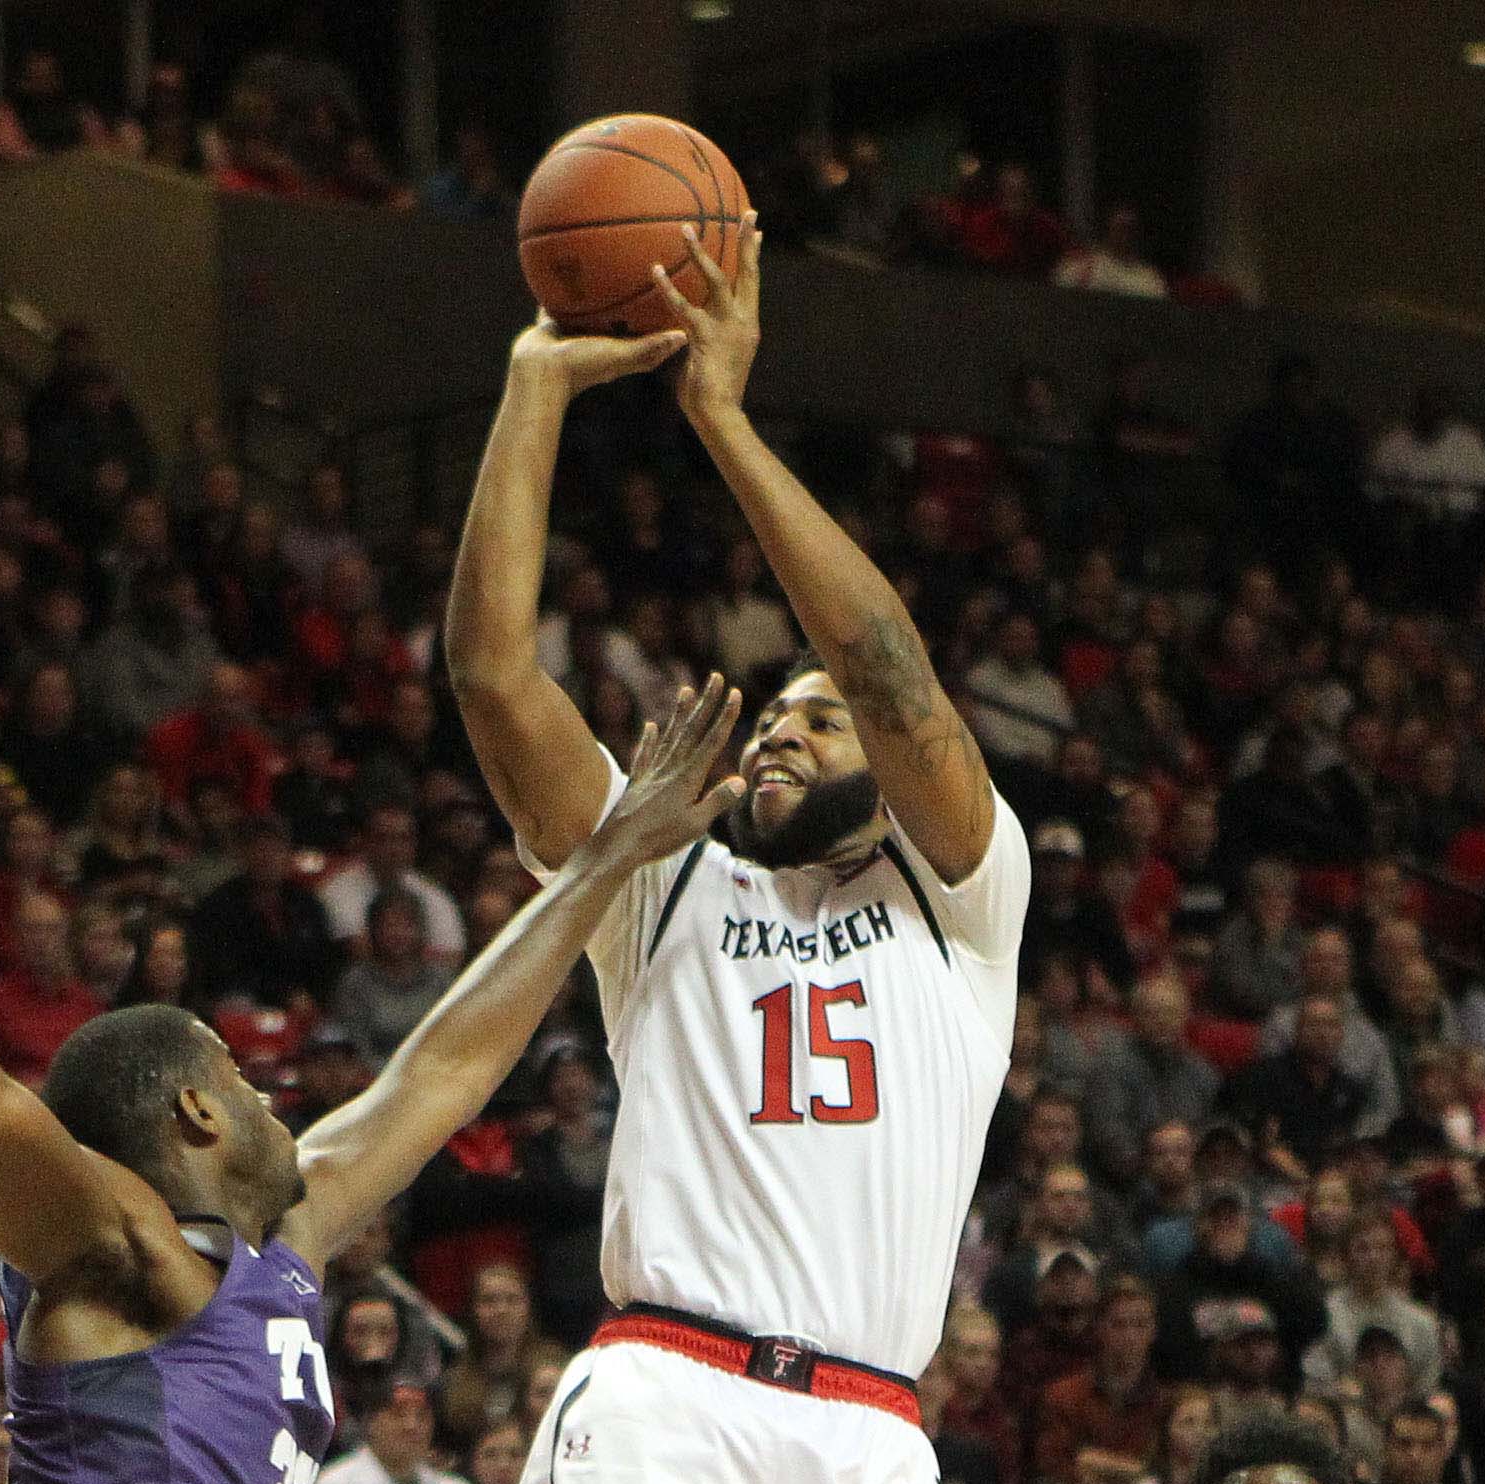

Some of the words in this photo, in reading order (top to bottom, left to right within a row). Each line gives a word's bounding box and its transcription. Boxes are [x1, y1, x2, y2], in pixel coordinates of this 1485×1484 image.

[720, 913, 818, 965] TEXAS
[822, 900, 896, 966] ECH
[749, 978, 880, 1124] 15
